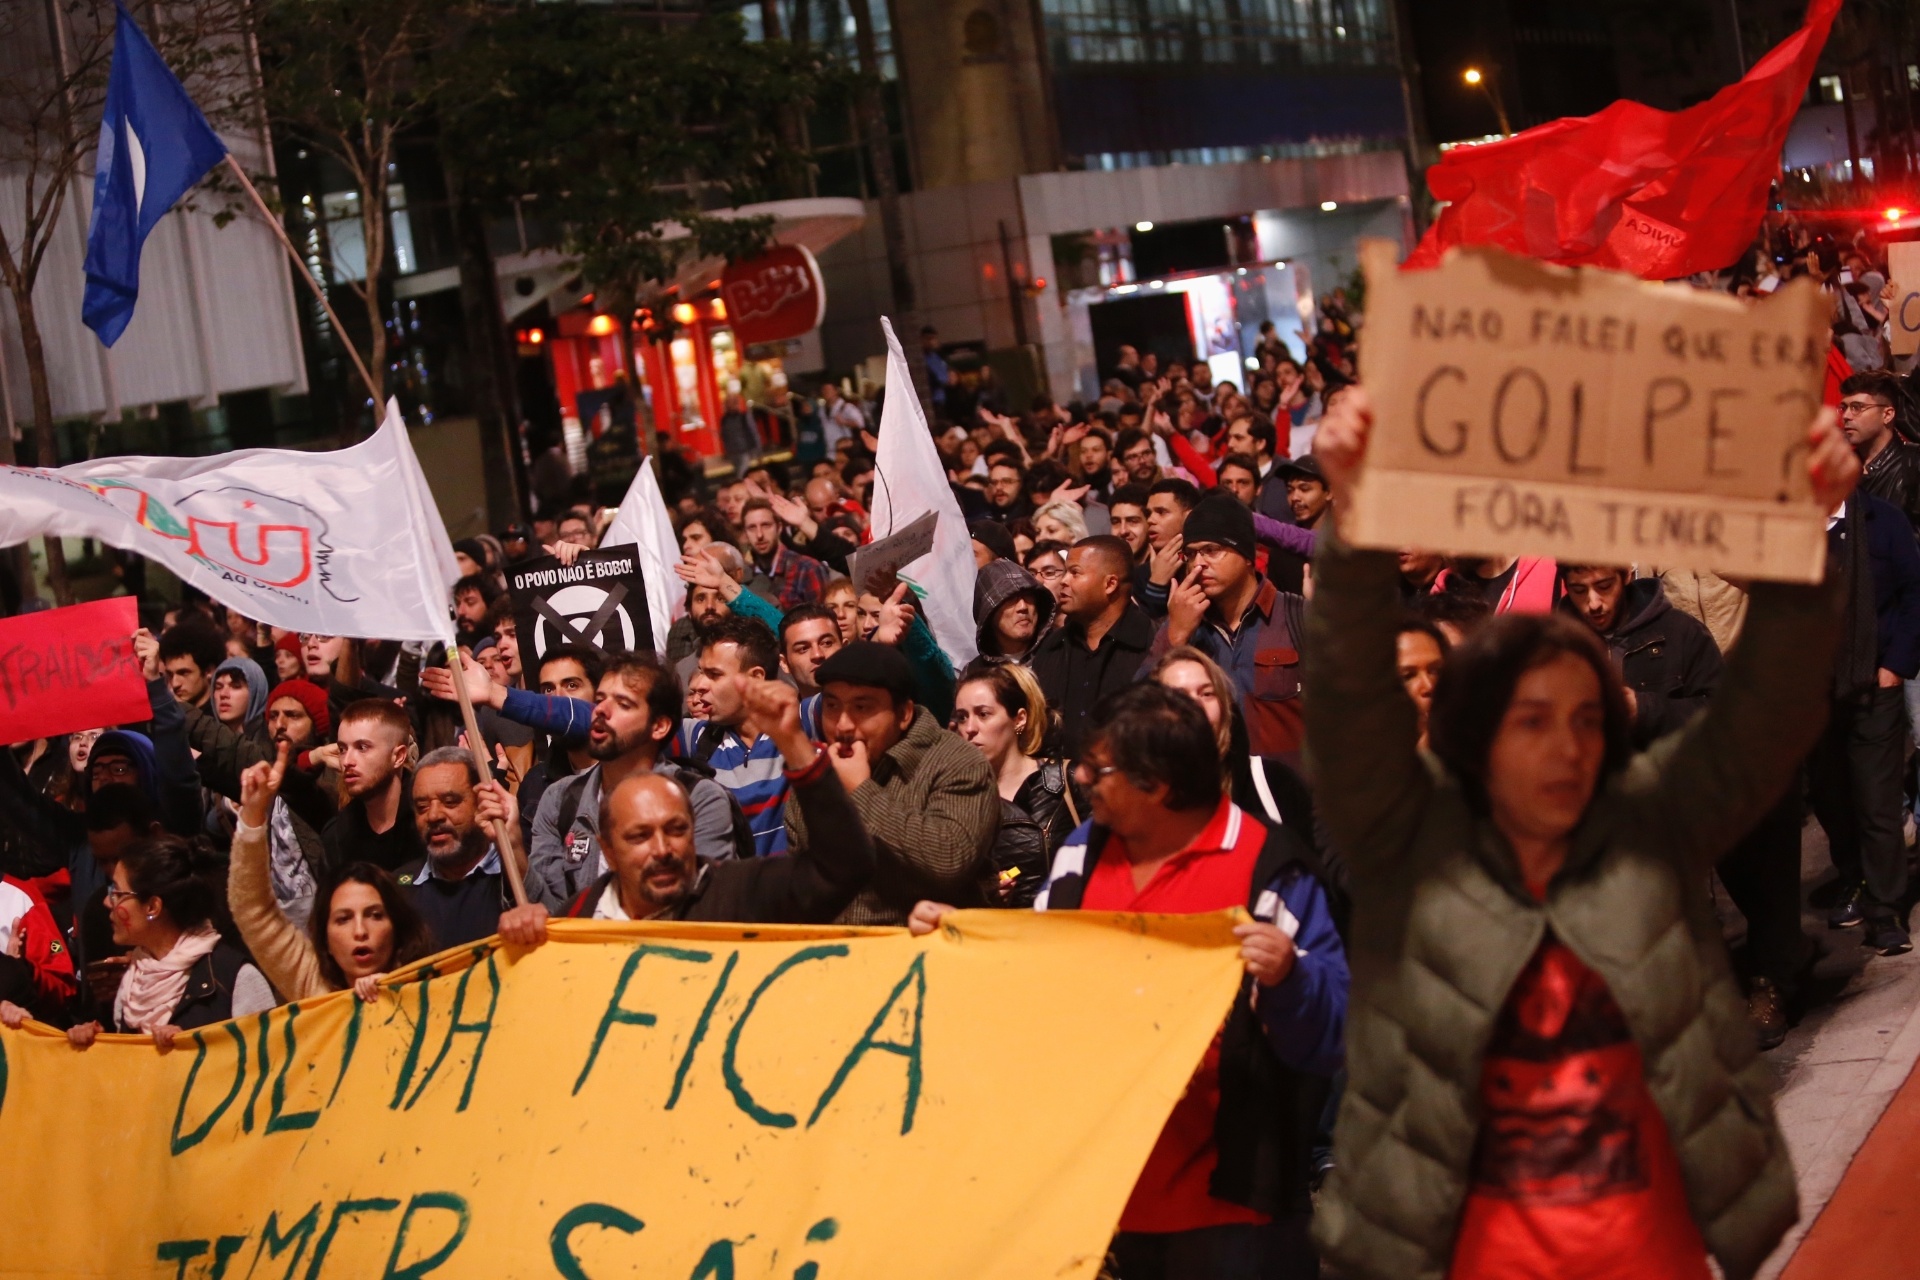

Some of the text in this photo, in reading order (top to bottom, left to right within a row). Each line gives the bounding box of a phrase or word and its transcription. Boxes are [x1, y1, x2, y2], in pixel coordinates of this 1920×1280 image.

[1529, 307, 1638, 353] FALEI
[1661, 323, 1734, 365] QUE
[1413, 364, 1817, 504] GOLPE?
[1453, 481, 1575, 539] FORA
[514, 574, 525, 590] O
[525, 569, 557, 589] POVO
[585, 560, 596, 579] É
[595, 558, 634, 578] BOBO!
[571, 943, 928, 1137] FICA
